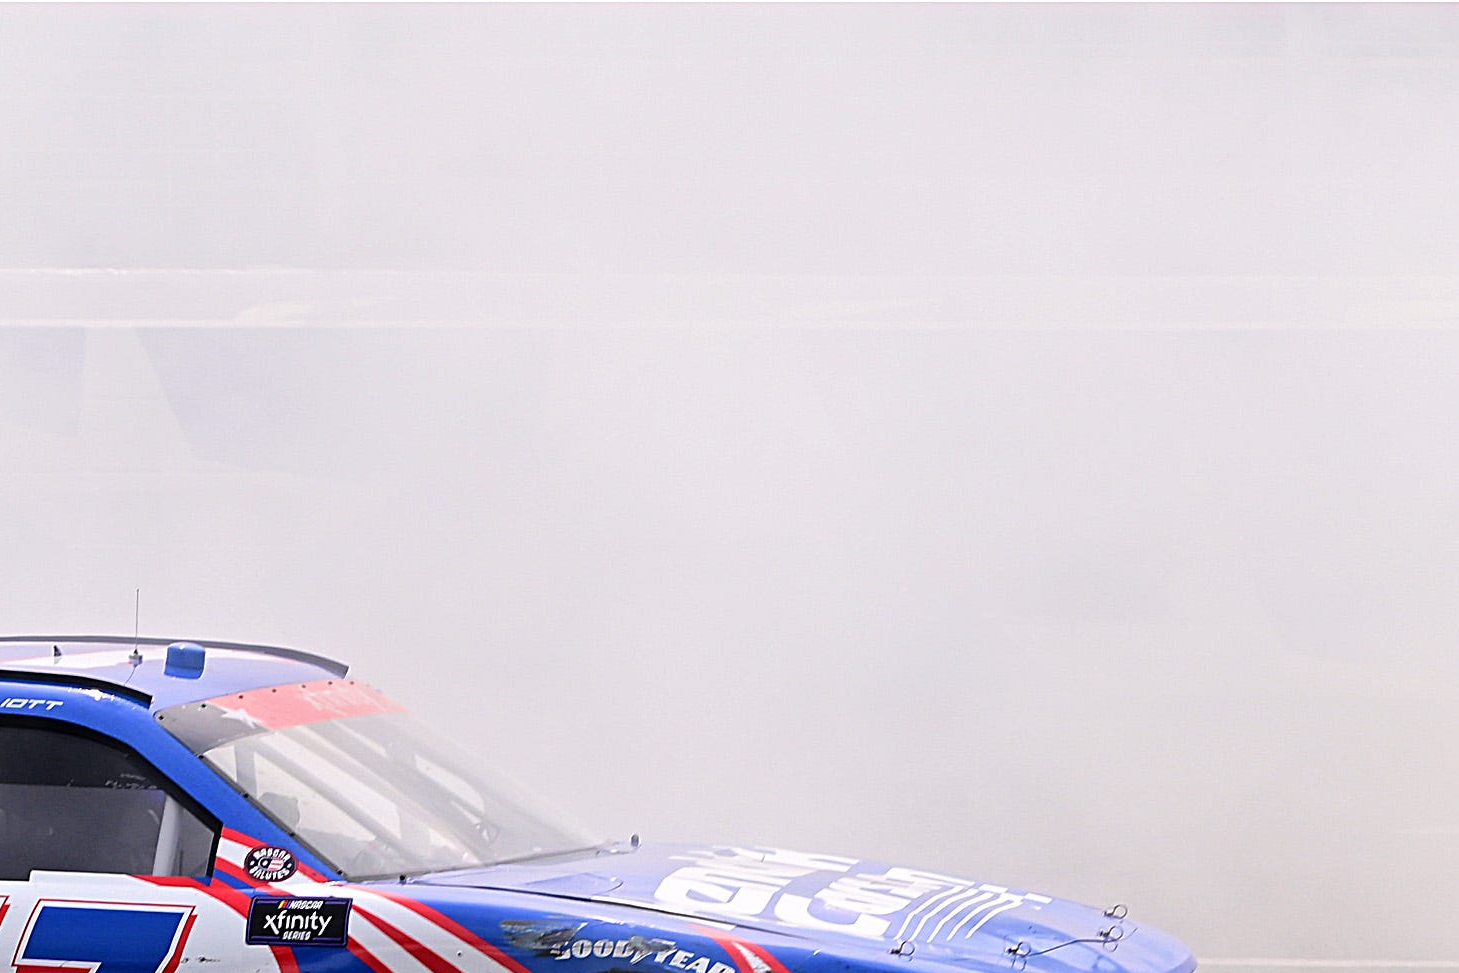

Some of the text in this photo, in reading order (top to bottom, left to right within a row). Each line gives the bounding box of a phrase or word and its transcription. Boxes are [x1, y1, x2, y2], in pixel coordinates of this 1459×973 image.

[253, 847, 291, 861] NASCAR
[249, 868, 290, 880] SALUTES
[288, 900, 323, 910] NASCAR
[263, 910, 332, 936] xfinity
[283, 931, 311, 940] SERIES
